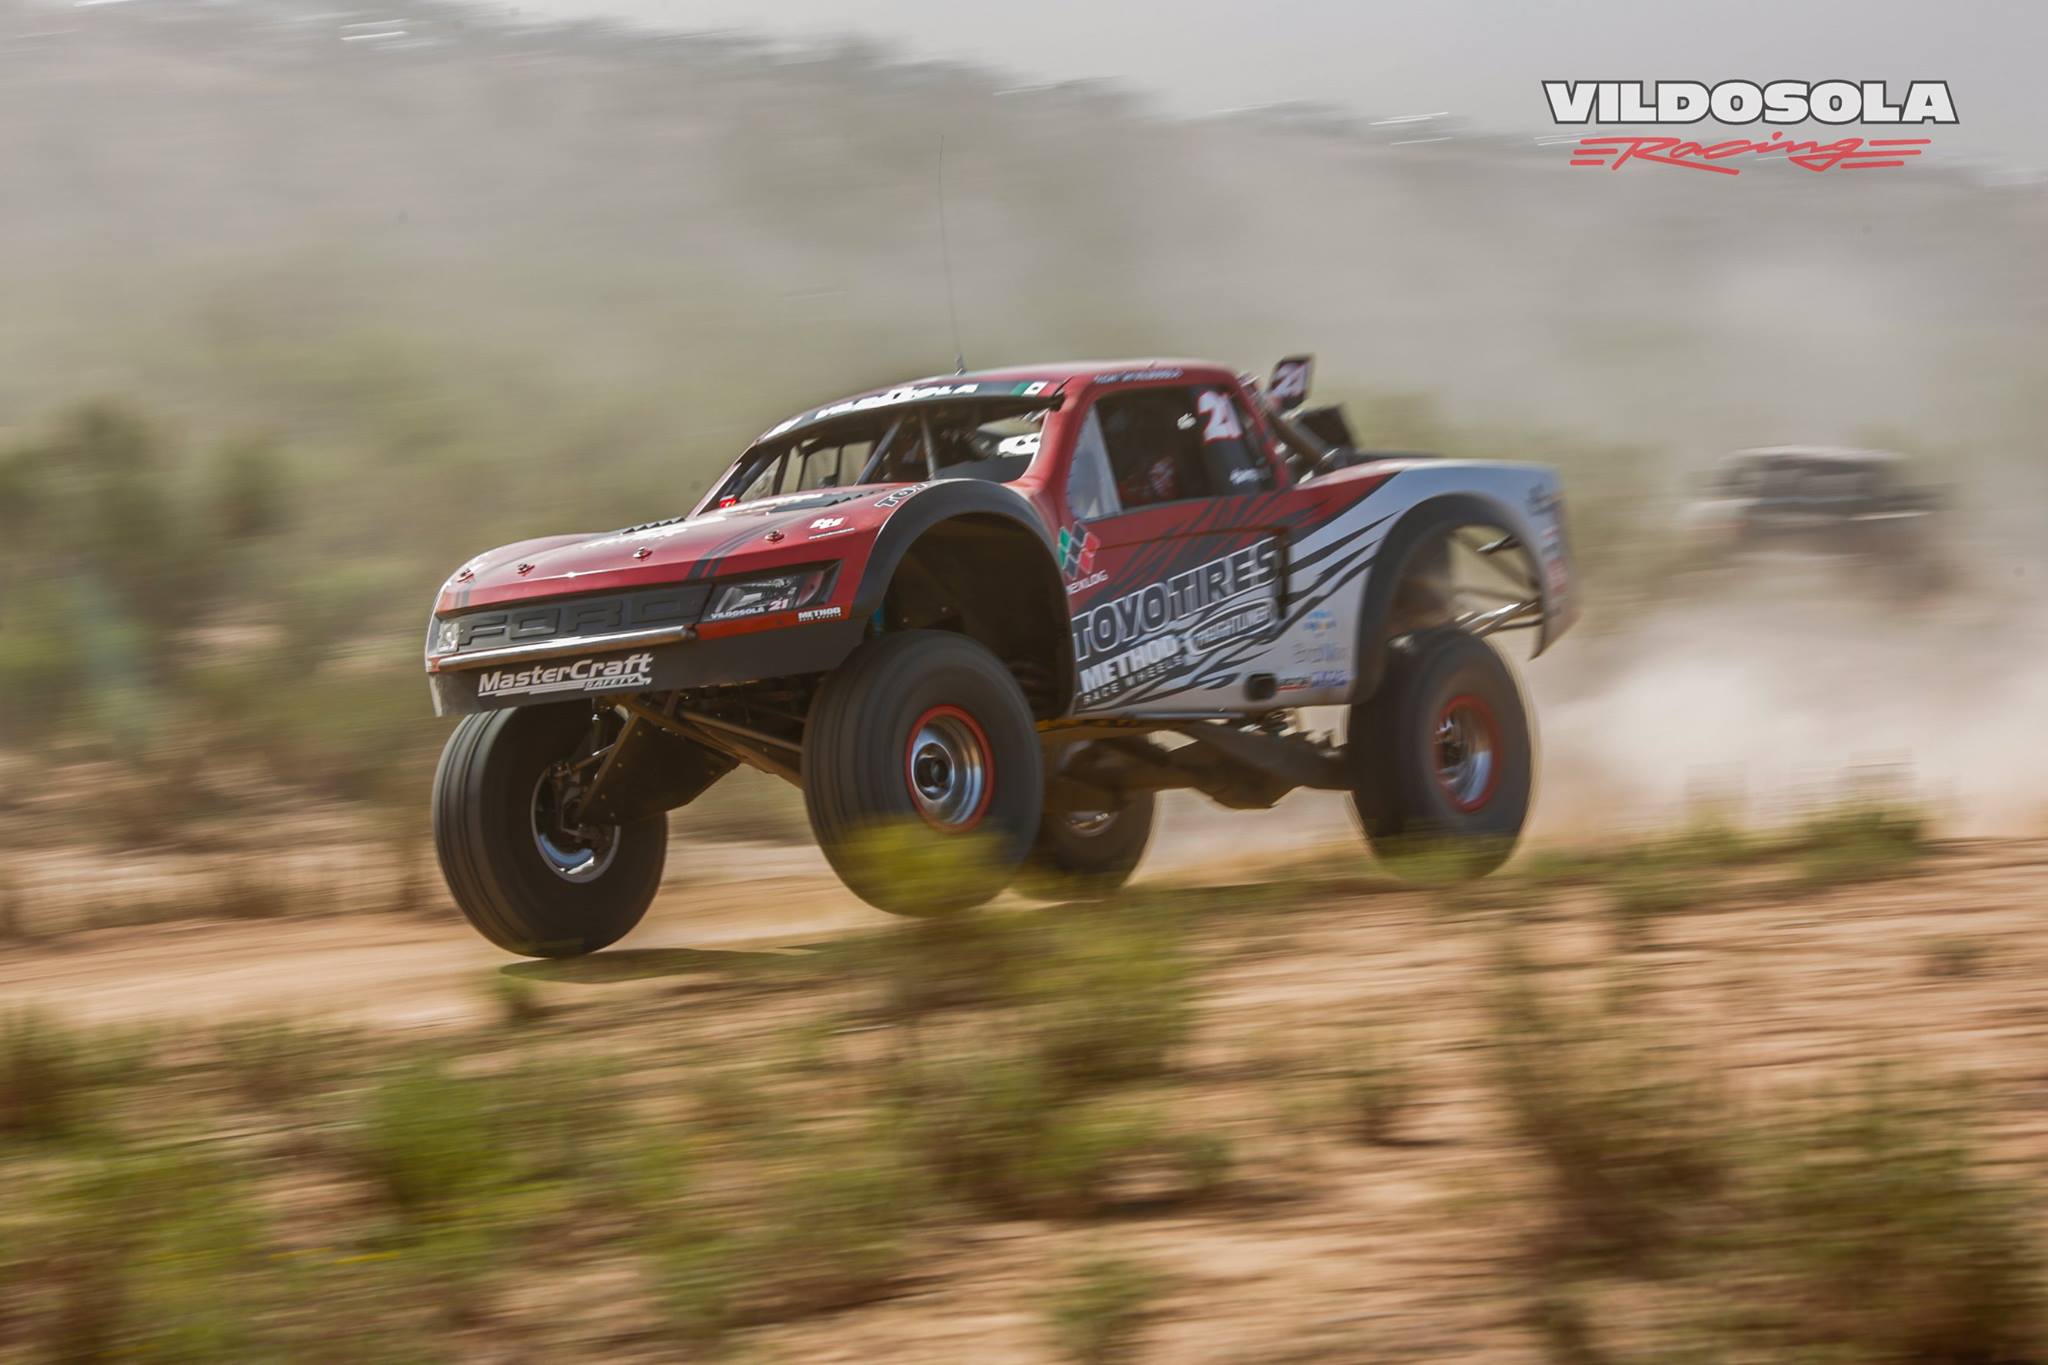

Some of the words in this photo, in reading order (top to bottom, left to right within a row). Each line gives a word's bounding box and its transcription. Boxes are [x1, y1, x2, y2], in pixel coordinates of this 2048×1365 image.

[456, 594, 702, 648] FORD
[710, 605, 765, 619] VILDOSOLA
[768, 598, 789, 611] 21
[798, 606, 841, 619] METHOD
[478, 652, 653, 693] MasterCraft
[1080, 634, 1179, 693] METHOD
[584, 674, 637, 690] SAFETY
